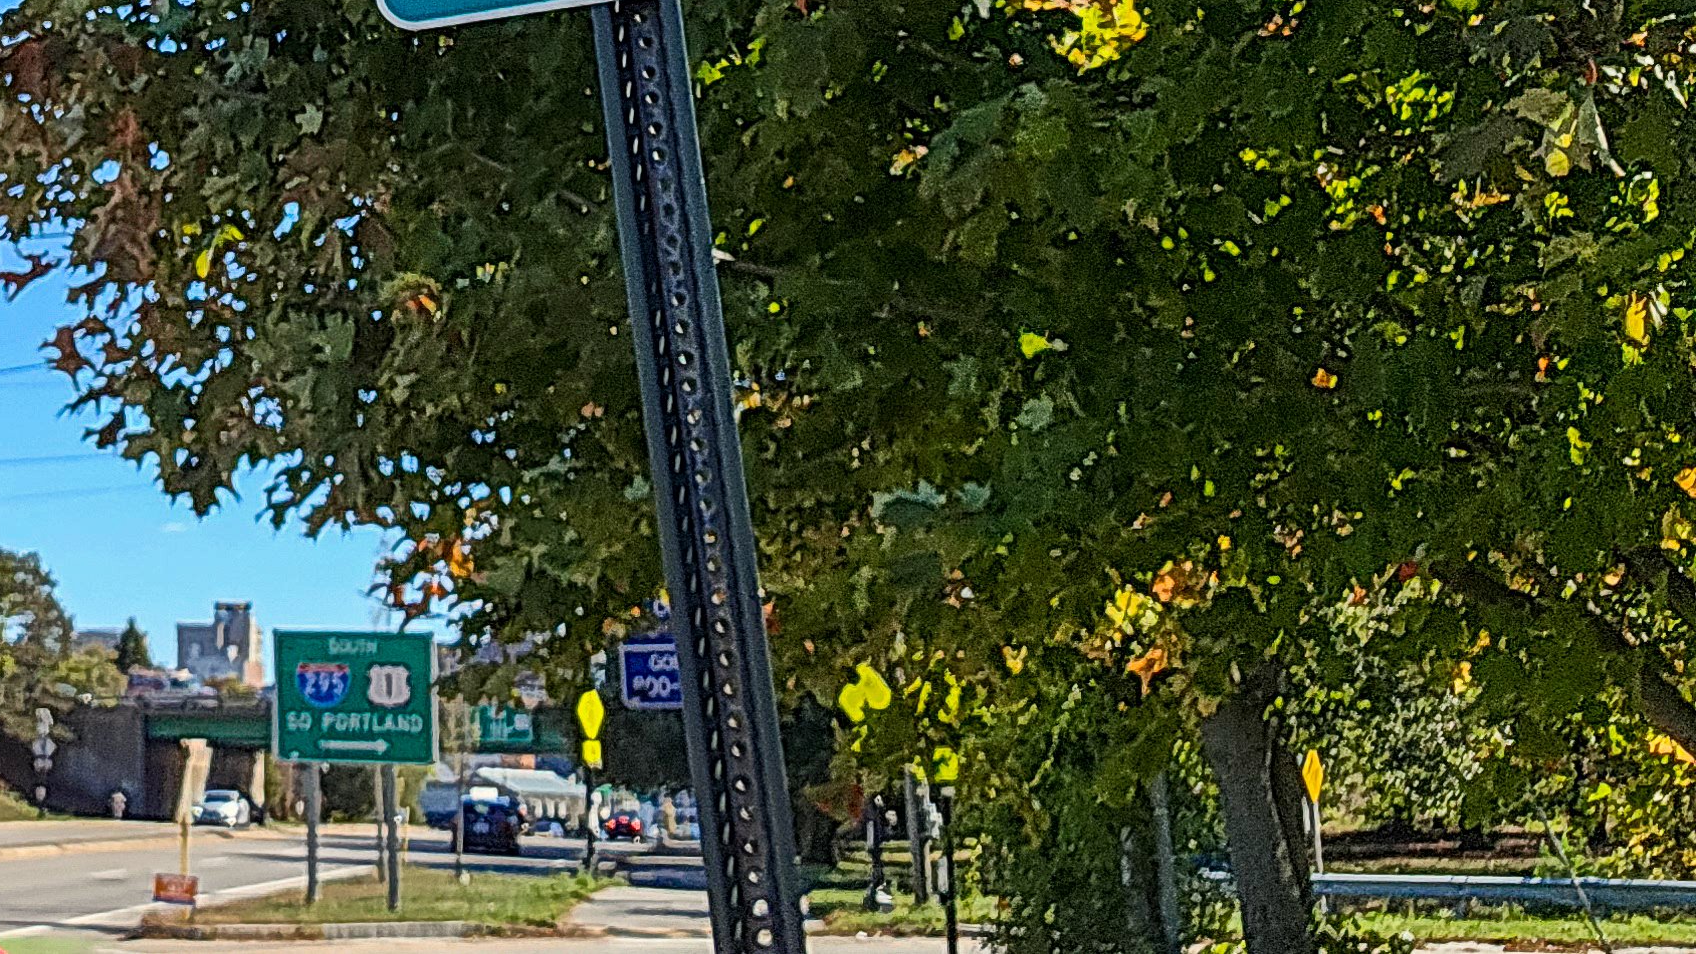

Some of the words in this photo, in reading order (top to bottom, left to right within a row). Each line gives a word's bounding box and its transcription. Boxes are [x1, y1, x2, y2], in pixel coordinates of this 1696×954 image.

[328, 636, 378, 655] SOUTH
[305, 671, 345, 697] 295
[384, 671, 394, 700] 1
[321, 710, 424, 734] PORTLAND
